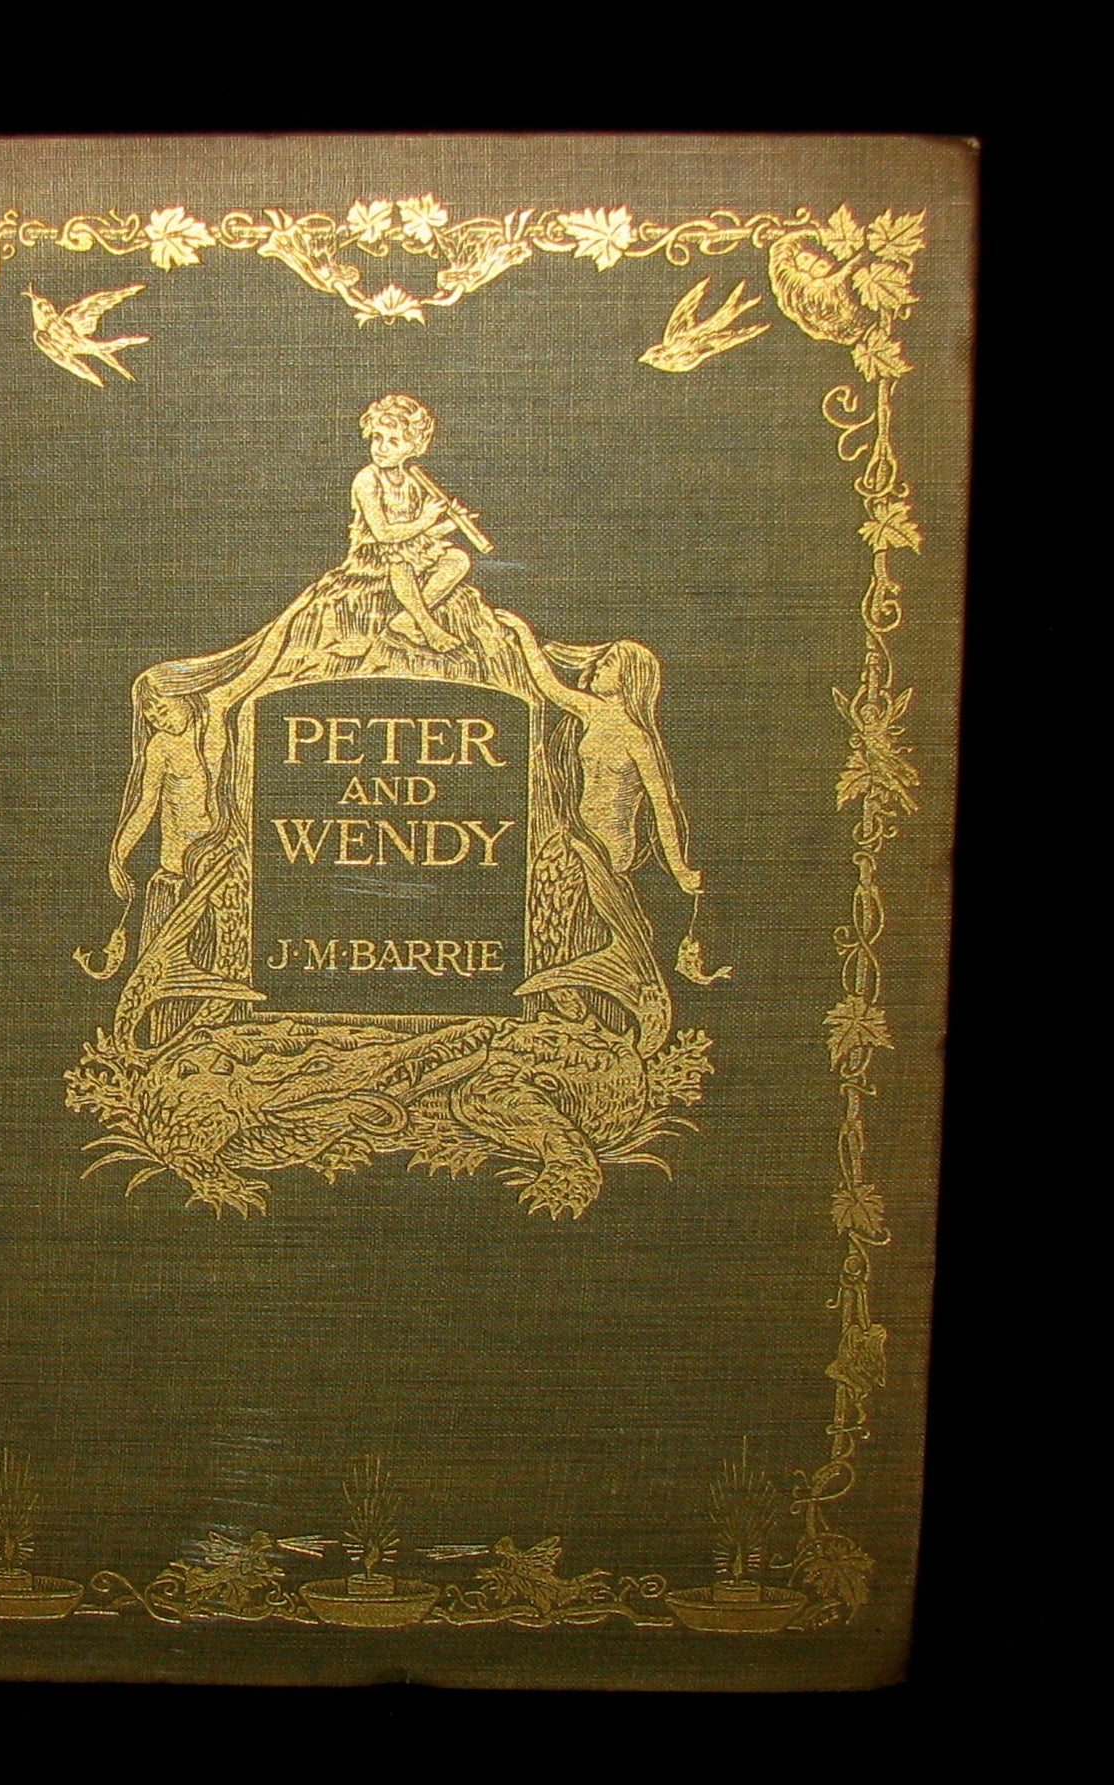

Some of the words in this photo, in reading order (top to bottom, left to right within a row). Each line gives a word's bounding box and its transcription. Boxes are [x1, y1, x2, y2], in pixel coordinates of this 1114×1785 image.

[283, 716, 507, 768] PETER
[337, 776, 436, 806] AND
[270, 818, 516, 866] WENDY
